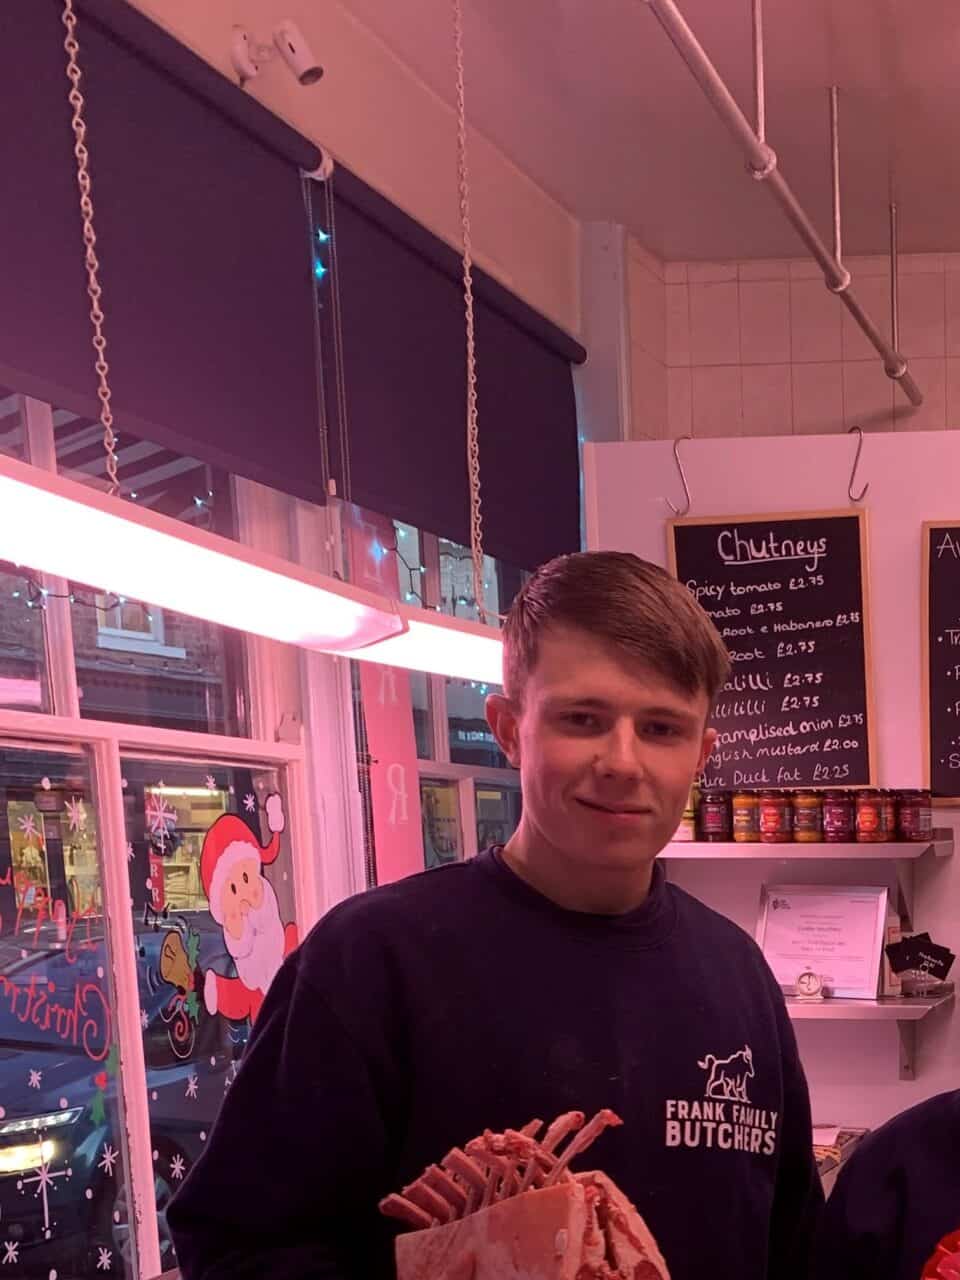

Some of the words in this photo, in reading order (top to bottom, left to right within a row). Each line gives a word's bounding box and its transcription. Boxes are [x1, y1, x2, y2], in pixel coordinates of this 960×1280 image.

[717, 528, 827, 572] Chutneys
[686, 579, 725, 600] Spicy
[730, 580, 782, 596] tomato
[788, 575, 824, 591] £2.75
[750, 601, 783, 615] £2.75
[776, 640, 816, 658] £2.75
[783, 672, 824, 688] £2.75
[781, 696, 820, 712] £2.75
[705, 746, 753, 769] nglish
[756, 740, 820, 758] mustard
[823, 738, 859, 752] £2.00
[733, 770, 771, 785] Duck
[776, 766, 803, 784] fat
[665, 1099, 725, 1122] FRANK
[732, 1105, 778, 1130] FAMILY
[665, 1120, 776, 1156] BUTCHERS
